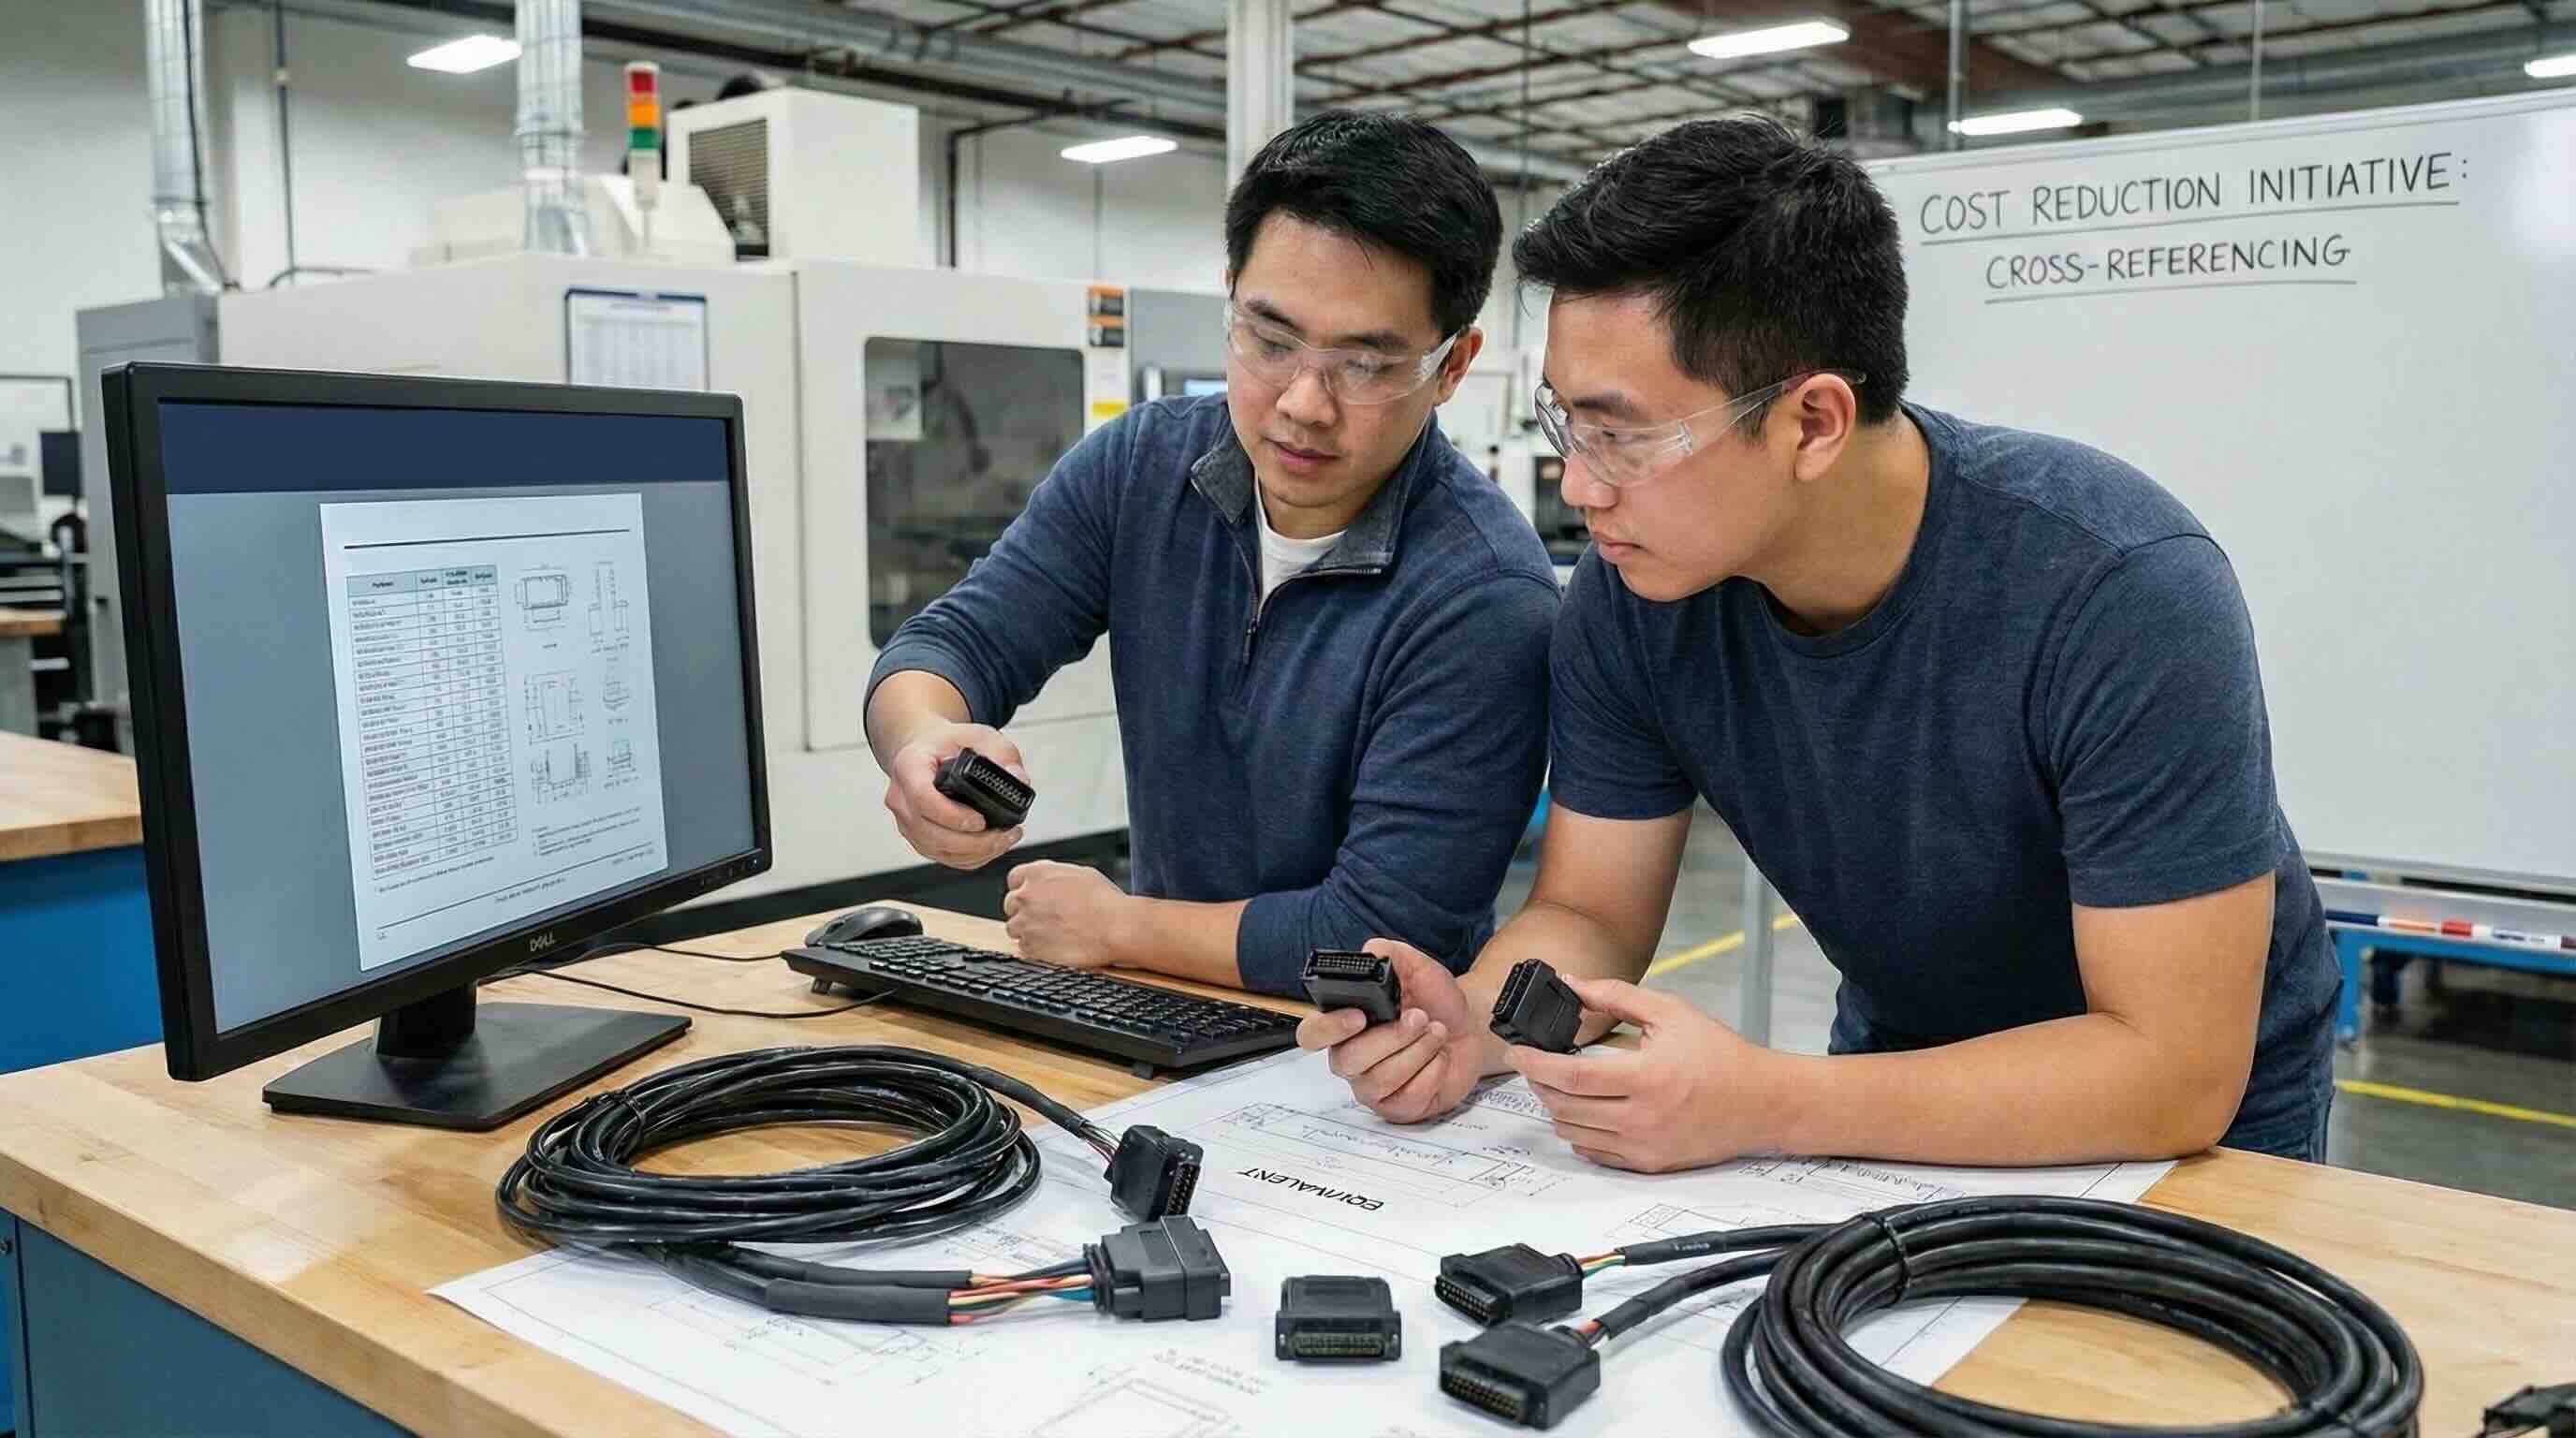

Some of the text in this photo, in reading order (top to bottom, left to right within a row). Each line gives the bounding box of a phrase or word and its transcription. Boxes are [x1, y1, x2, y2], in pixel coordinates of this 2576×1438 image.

[1921, 152, 2469, 234] COST REDUCTION INITIATIVE:
[1985, 234, 2351, 289] CROSS-REFERENCING
